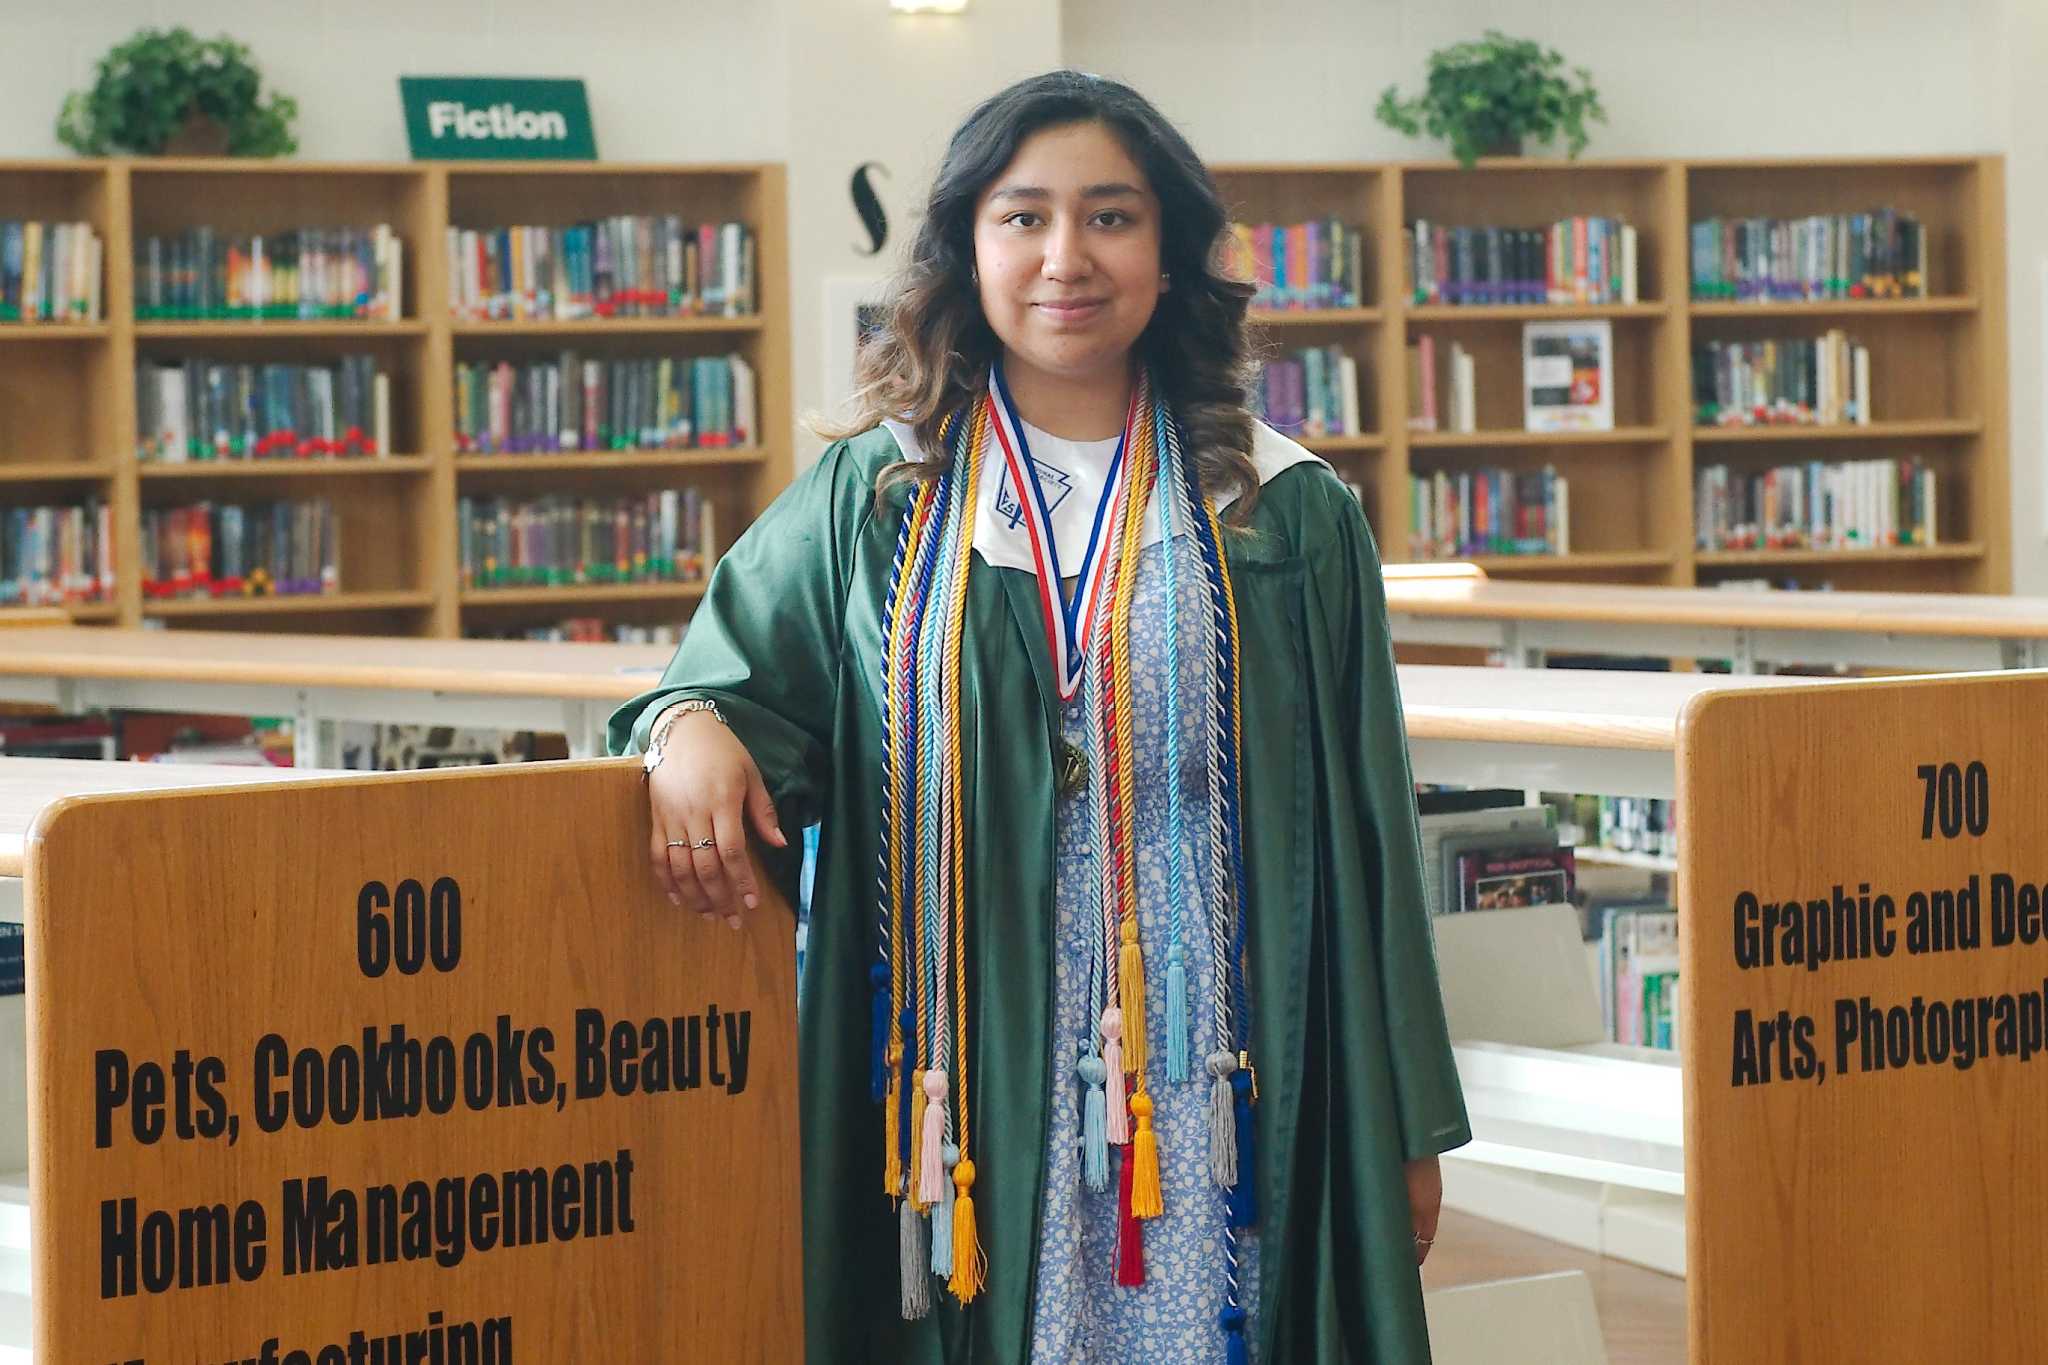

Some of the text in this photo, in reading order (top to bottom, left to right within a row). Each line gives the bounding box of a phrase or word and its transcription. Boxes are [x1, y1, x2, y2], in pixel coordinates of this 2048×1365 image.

[427, 101, 568, 140] Fiction
[1915, 760, 1989, 840] 700
[356, 876, 462, 979] 600
[1732, 872, 2048, 972] Graphic and De
[94, 1003, 752, 1149] Pets, Cookbooks, Beauty
[1731, 977, 2048, 1088] Arts, Photograp
[100, 1148, 635, 1300] Home Management
